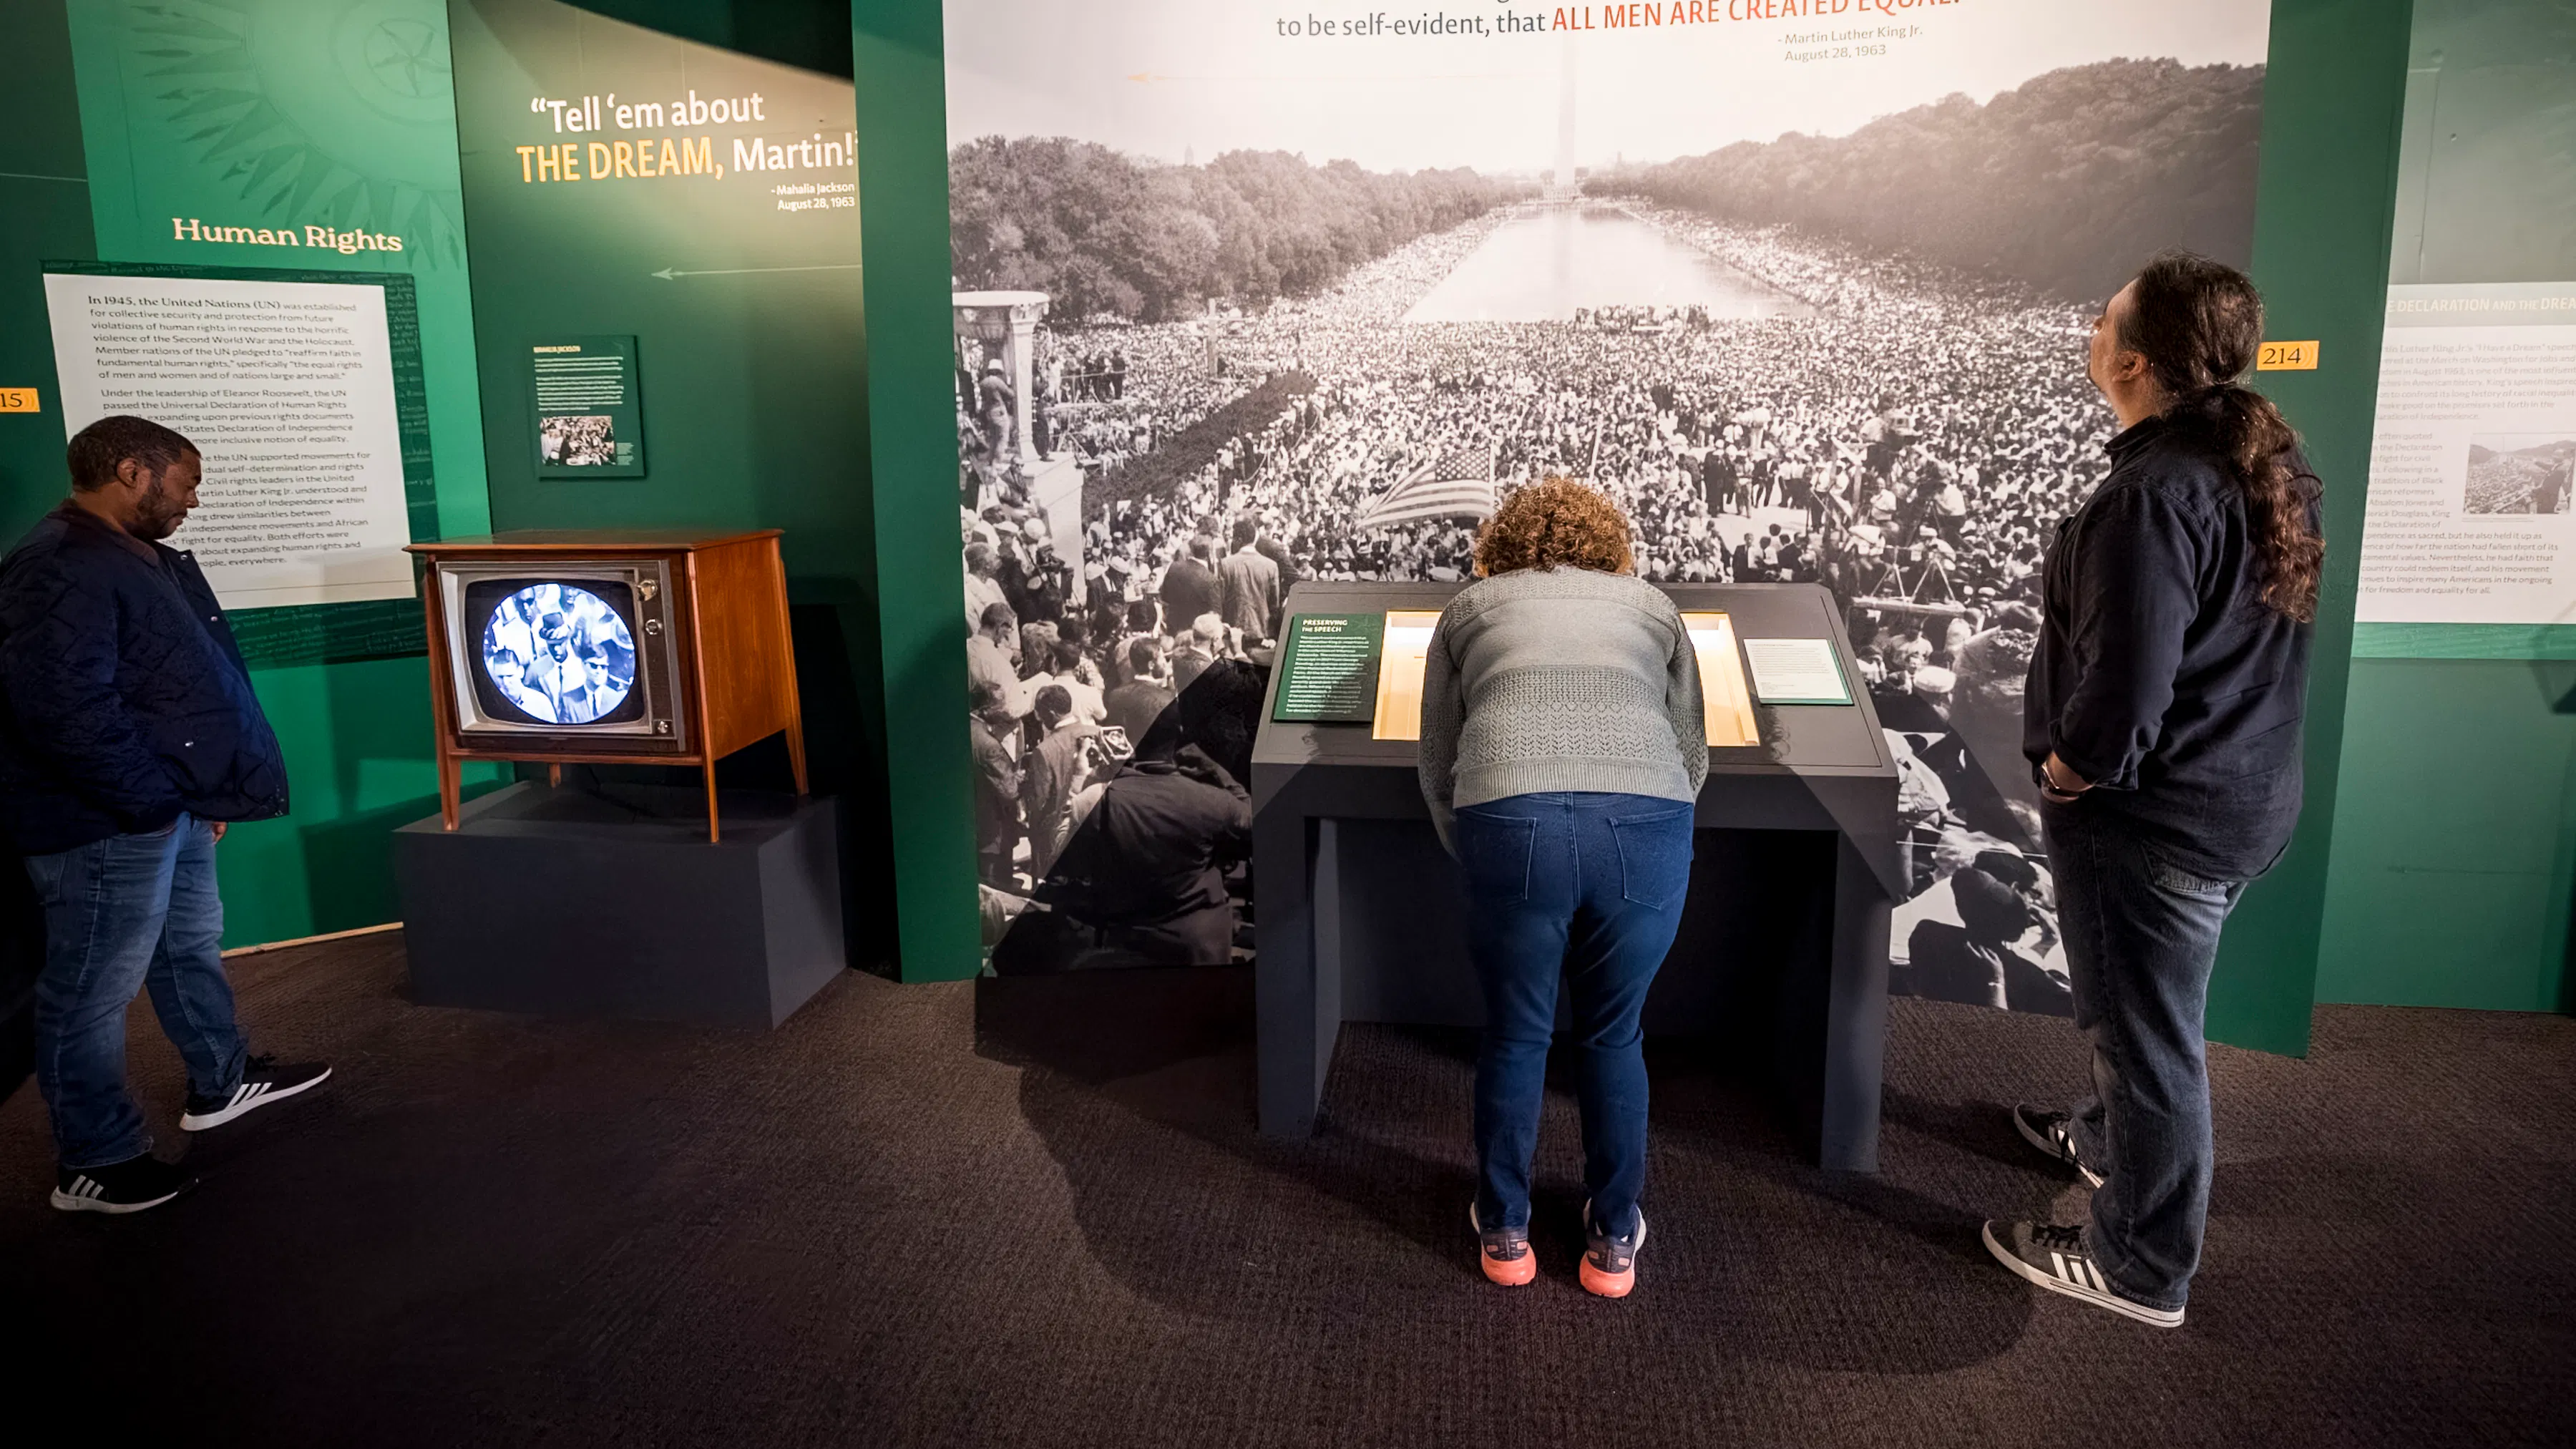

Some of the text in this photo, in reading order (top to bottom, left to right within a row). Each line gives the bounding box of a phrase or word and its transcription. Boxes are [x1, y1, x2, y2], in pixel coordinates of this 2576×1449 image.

[1277, 17, 1301, 36] to
[1308, 14, 1336, 36] be
[1342, 12, 1491, 37] self-evident,
[1496, 10, 1546, 34] that
[1552, 7, 1596, 30] ALL
[1604, 3, 1662, 29] MEN
[1670, 0, 1719, 26] ARE
[1785, 31, 1828, 45] Martin
[1831, 28, 1873, 42] Luther
[1877, 26, 1906, 40] King
[1909, 24, 1923, 38] Jr.
[1784, 44, 1887, 63] August 28, 1963
[530, 94, 601, 134] “Tell
[670, 89, 765, 127] about
[516, 143, 581, 183] THE
[588, 136, 724, 180] DREAM,
[816, 181, 855, 195] Jackson
[778, 196, 855, 212] August 28, 1963
[172, 218, 402, 255] Human Rights
[88, 295, 102, 304] In
[104, 296, 136, 306] 1945,
[139, 297, 159, 306] the
[162, 297, 203, 307] United
[205, 299, 250, 308] Nations
[253, 300, 280, 310] (UN)
[2397, 298, 2489, 313] DECLARATION
[2493, 300, 2515, 311] AND
[2519, 299, 2537, 310] THE
[90, 308, 106, 317] for
[109, 309, 159, 318] collective
[161, 311, 202, 319] security
[91, 321, 144, 330] violations
[146, 322, 156, 331] of
[196, 324, 225, 333] rights
[140, 334, 150, 343] of
[172, 335, 210, 343] Second
[212, 336, 243, 344] World
[95, 346, 139, 354] Member
[142, 347, 180, 356] nations
[213, 347, 230, 356] UN
[232, 348, 270, 357] pledged
[2263, 347, 2302, 365] 214
[97, 358, 162, 367] fundamental
[337, 361, 362, 370] rights
[98, 370, 109, 379] of
[219, 371, 230, 379] of
[101, 389, 133, 397] Under
[223, 389, 259, 397] Eleanor
[269, 400, 279, 409] of
[317, 401, 347, 409] Rights
[2537, 542, 2546, 551] of
[2491, 564, 2503, 572] his
[2396, 574, 2424, 583] inspire
[2494, 575, 2502, 583] in
[2431, 585, 2464, 595] equality
[2466, 585, 2477, 594] for
